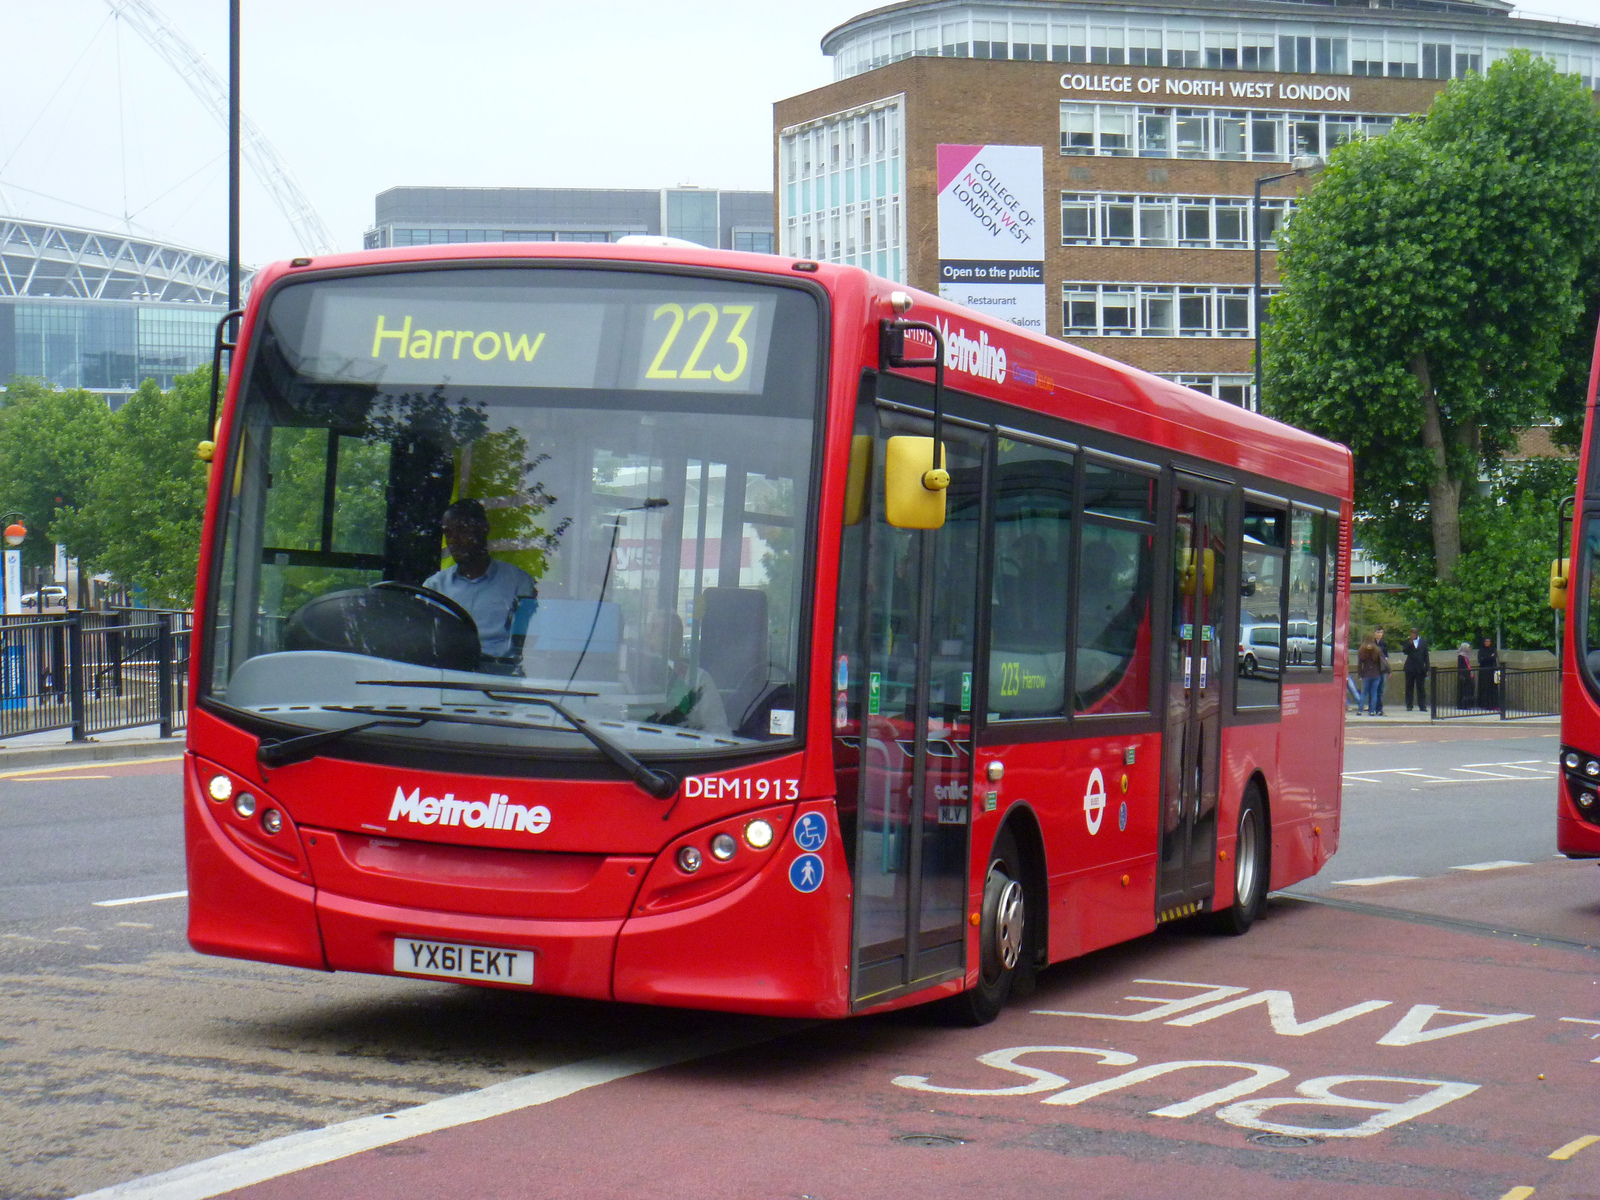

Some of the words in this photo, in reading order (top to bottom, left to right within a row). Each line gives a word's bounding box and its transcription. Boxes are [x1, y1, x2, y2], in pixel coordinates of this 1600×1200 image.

[1059, 73, 1133, 93] COLLEGE
[1137, 77, 1161, 94] OF
[1165, 79, 1224, 97] NORTH
[1229, 81, 1274, 99] WEST
[1279, 83, 1350, 101] LONDON
[952, 184, 1001, 237] LONDON
[963, 173, 1003, 216] NORTH
[1001, 211, 1031, 244] WEST
[974, 163, 1020, 212] COLLEGE
[1018, 210, 1036, 226] OF
[943, 265, 973, 280] Open
[974, 267, 987, 277] to
[989, 266, 1006, 278] the
[1008, 266, 1040, 280] public
[967, 295, 1017, 305] Restaurant
[371, 315, 546, 362] Harrow
[1011, 317, 1041, 327] Salons
[645, 303, 755, 382] 223
[934, 315, 1007, 384] Metroline
[1001, 662, 1020, 696] 223
[1022, 669, 1047, 689] Harrow
[684, 776, 800, 801] DEM1913
[388, 785, 551, 834] Metroline
[410, 943, 463, 971] YX61
[470, 949, 518, 977] EKT
[891, 1045, 1482, 1138] BUS
